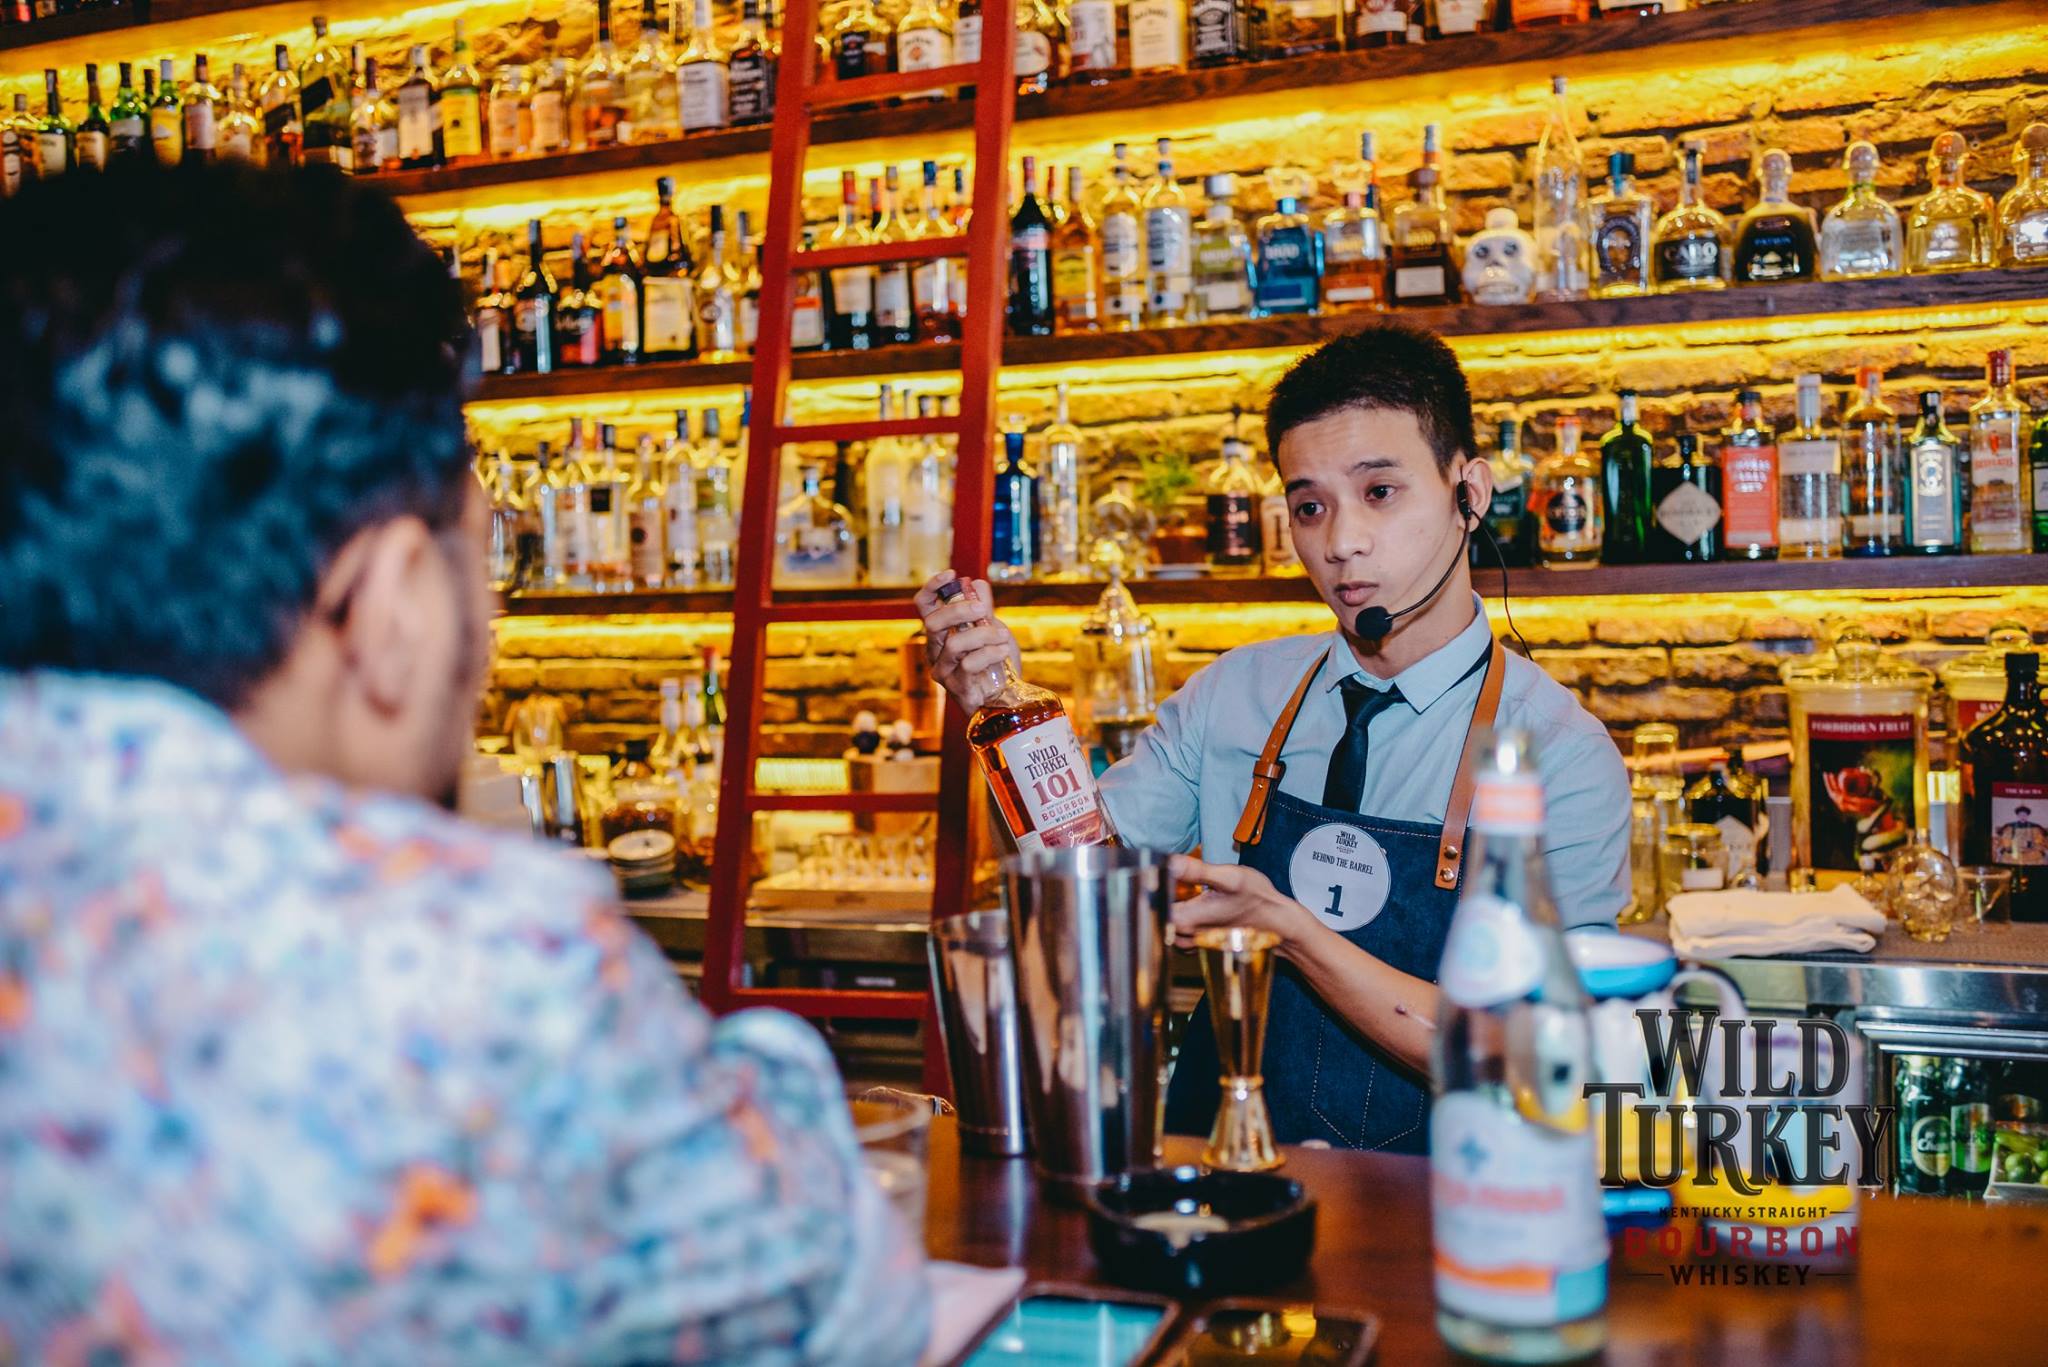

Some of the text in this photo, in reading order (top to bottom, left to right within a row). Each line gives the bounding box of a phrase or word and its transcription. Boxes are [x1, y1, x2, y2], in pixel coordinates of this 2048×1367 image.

[1811, 721, 1910, 733] FORBIDDEN FRUIT
[1028, 744, 1059, 764] WILD
[1024, 753, 1069, 780] TURKEY
[1032, 767, 1082, 806] 101
[1041, 795, 1090, 822] BOURBON
[1055, 806, 1085, 822] WHISKEY
[1335, 834, 1359, 849] TURKEY
[1340, 830, 1356, 841] WILD
[1312, 850, 1335, 865] BEHIND
[1336, 857, 1348, 868] THE
[1349, 860, 1374, 875] BARREL
[1324, 884, 1344, 918] 1
